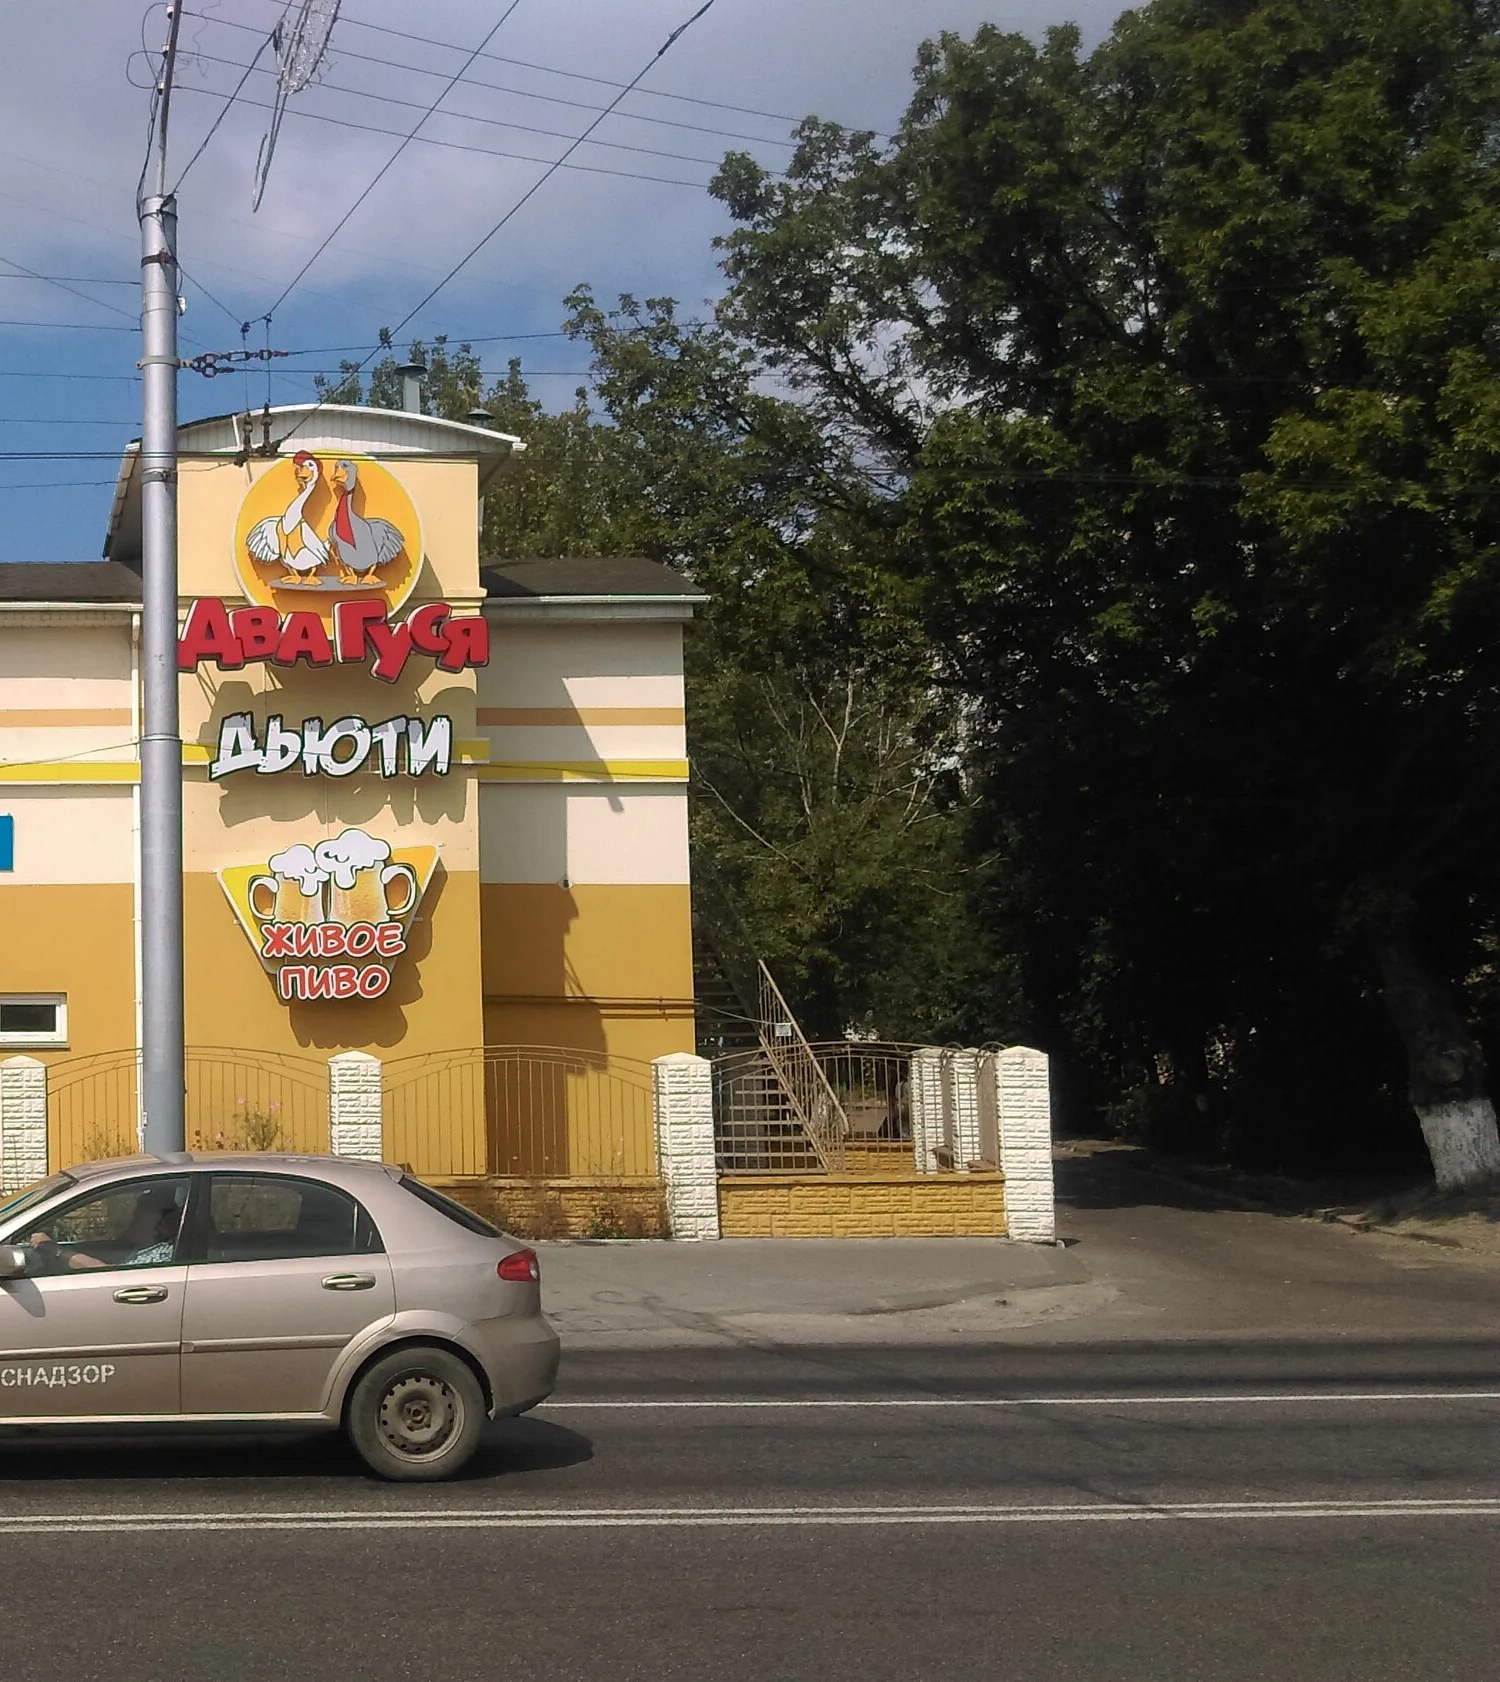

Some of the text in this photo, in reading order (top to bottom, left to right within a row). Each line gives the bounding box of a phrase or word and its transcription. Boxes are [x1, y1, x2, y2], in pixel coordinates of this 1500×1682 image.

[178, 598, 490, 684] ДВА ГУСЯ
[209, 711, 453, 781] ДЬЮТИ
[261, 921, 406, 958] ЖИВОЕ
[279, 964, 391, 1000] ПИВО
